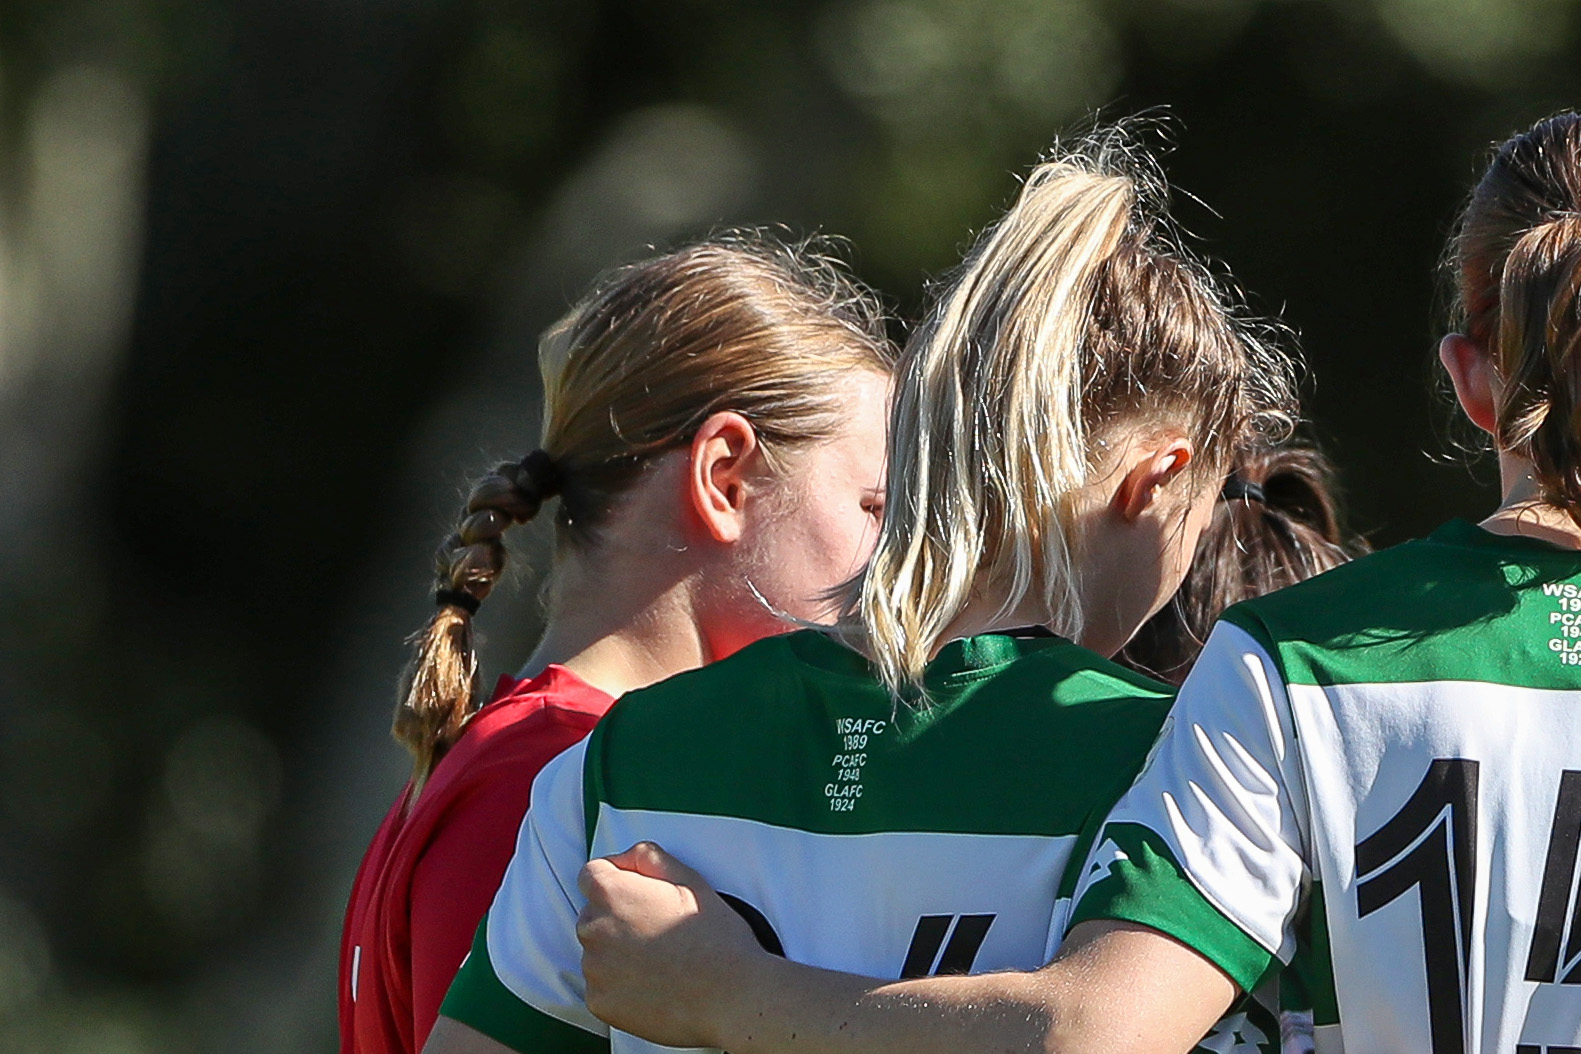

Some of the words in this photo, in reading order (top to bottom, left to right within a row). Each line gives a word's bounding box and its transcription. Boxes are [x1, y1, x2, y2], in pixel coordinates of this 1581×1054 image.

[832, 754, 867, 767] PCAFC
[825, 784, 863, 797] GLAFC
[830, 798, 855, 811] 1924
